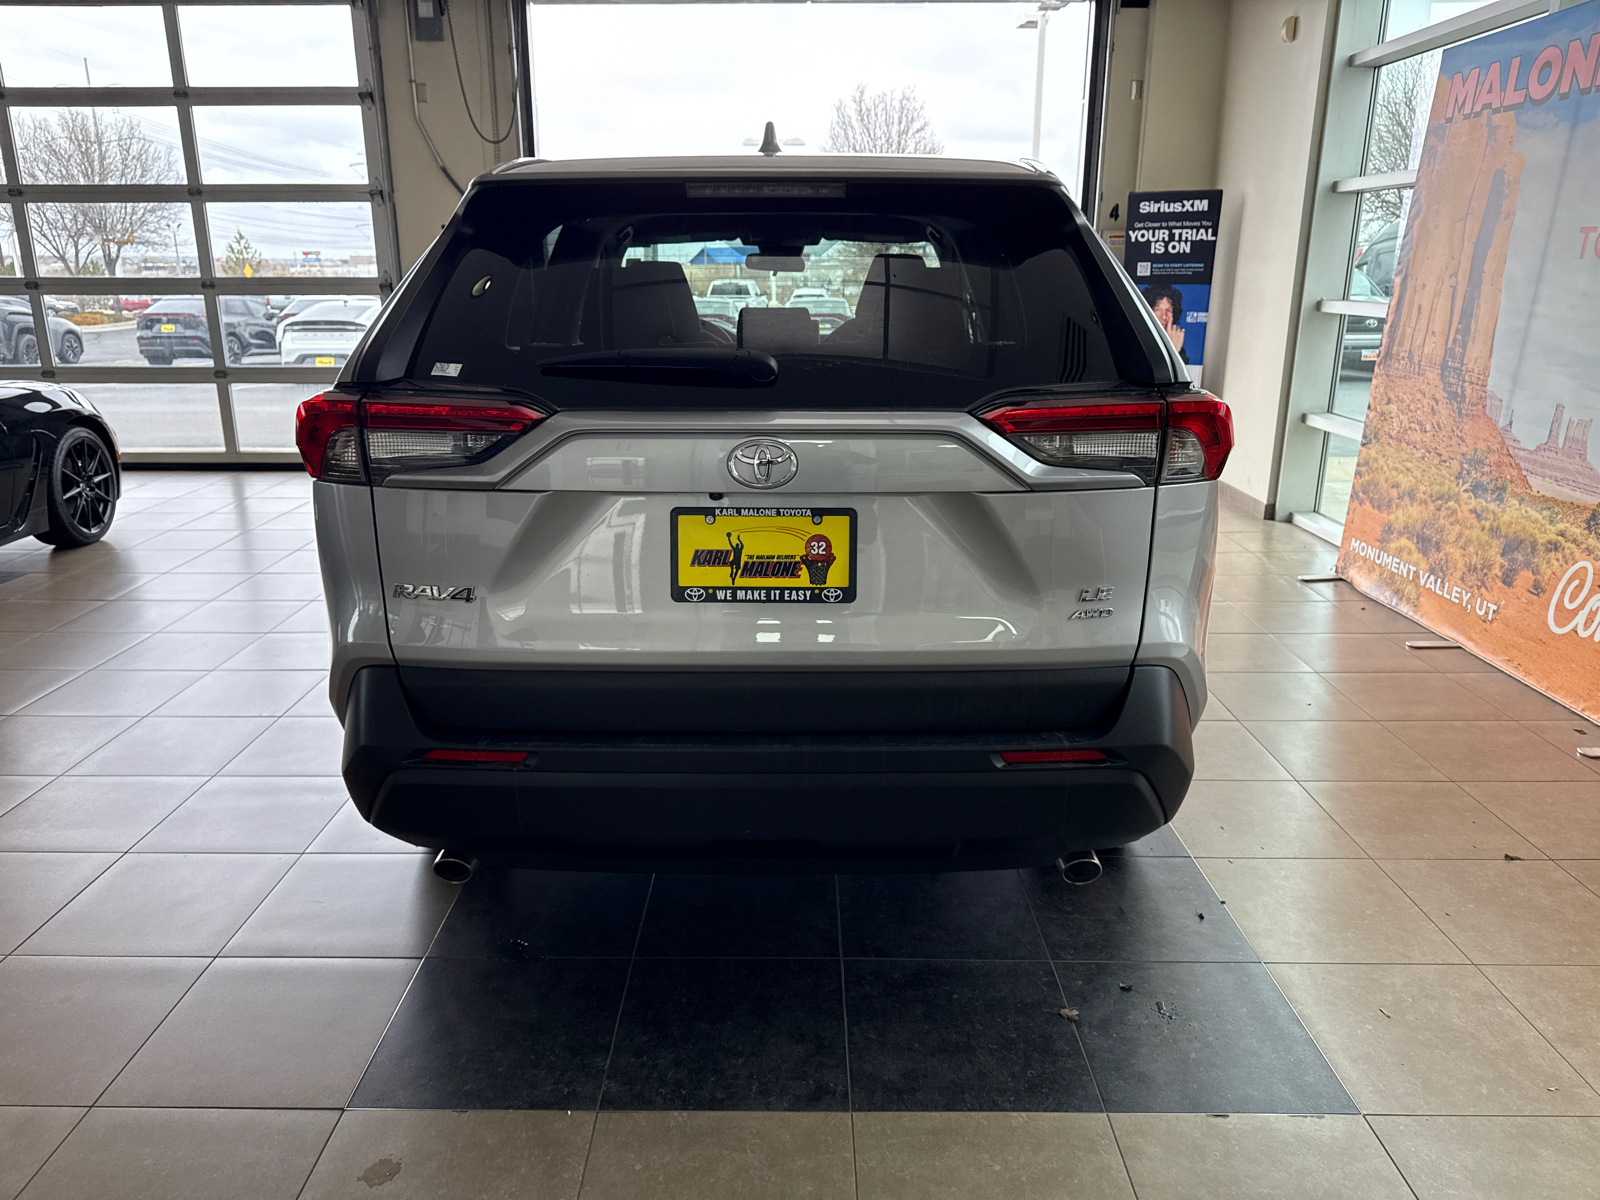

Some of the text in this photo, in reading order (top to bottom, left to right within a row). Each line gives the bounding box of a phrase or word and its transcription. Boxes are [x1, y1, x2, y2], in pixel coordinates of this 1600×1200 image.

[1443, 32, 1600, 124] MALON
[1109, 203, 1120, 222] 4
[1139, 199, 1208, 213] SiriusXM
[1128, 229, 1170, 242] YOUR
[1172, 228, 1216, 242] TRIAL
[1150, 241, 1191, 254] IS ON
[715, 508, 812, 517] KARL MALONE TOYOTA
[810, 541, 827, 555] 32
[690, 549, 733, 567] KARL
[739, 560, 804, 578] MALONE
[1350, 537, 1498, 621] MONUMENT VALLEY, UT
[392, 582, 477, 604] RAV4
[716, 590, 812, 601] WE MAKE IT EASY
[1078, 586, 1115, 602] LE
[1067, 607, 1115, 621] AWD
